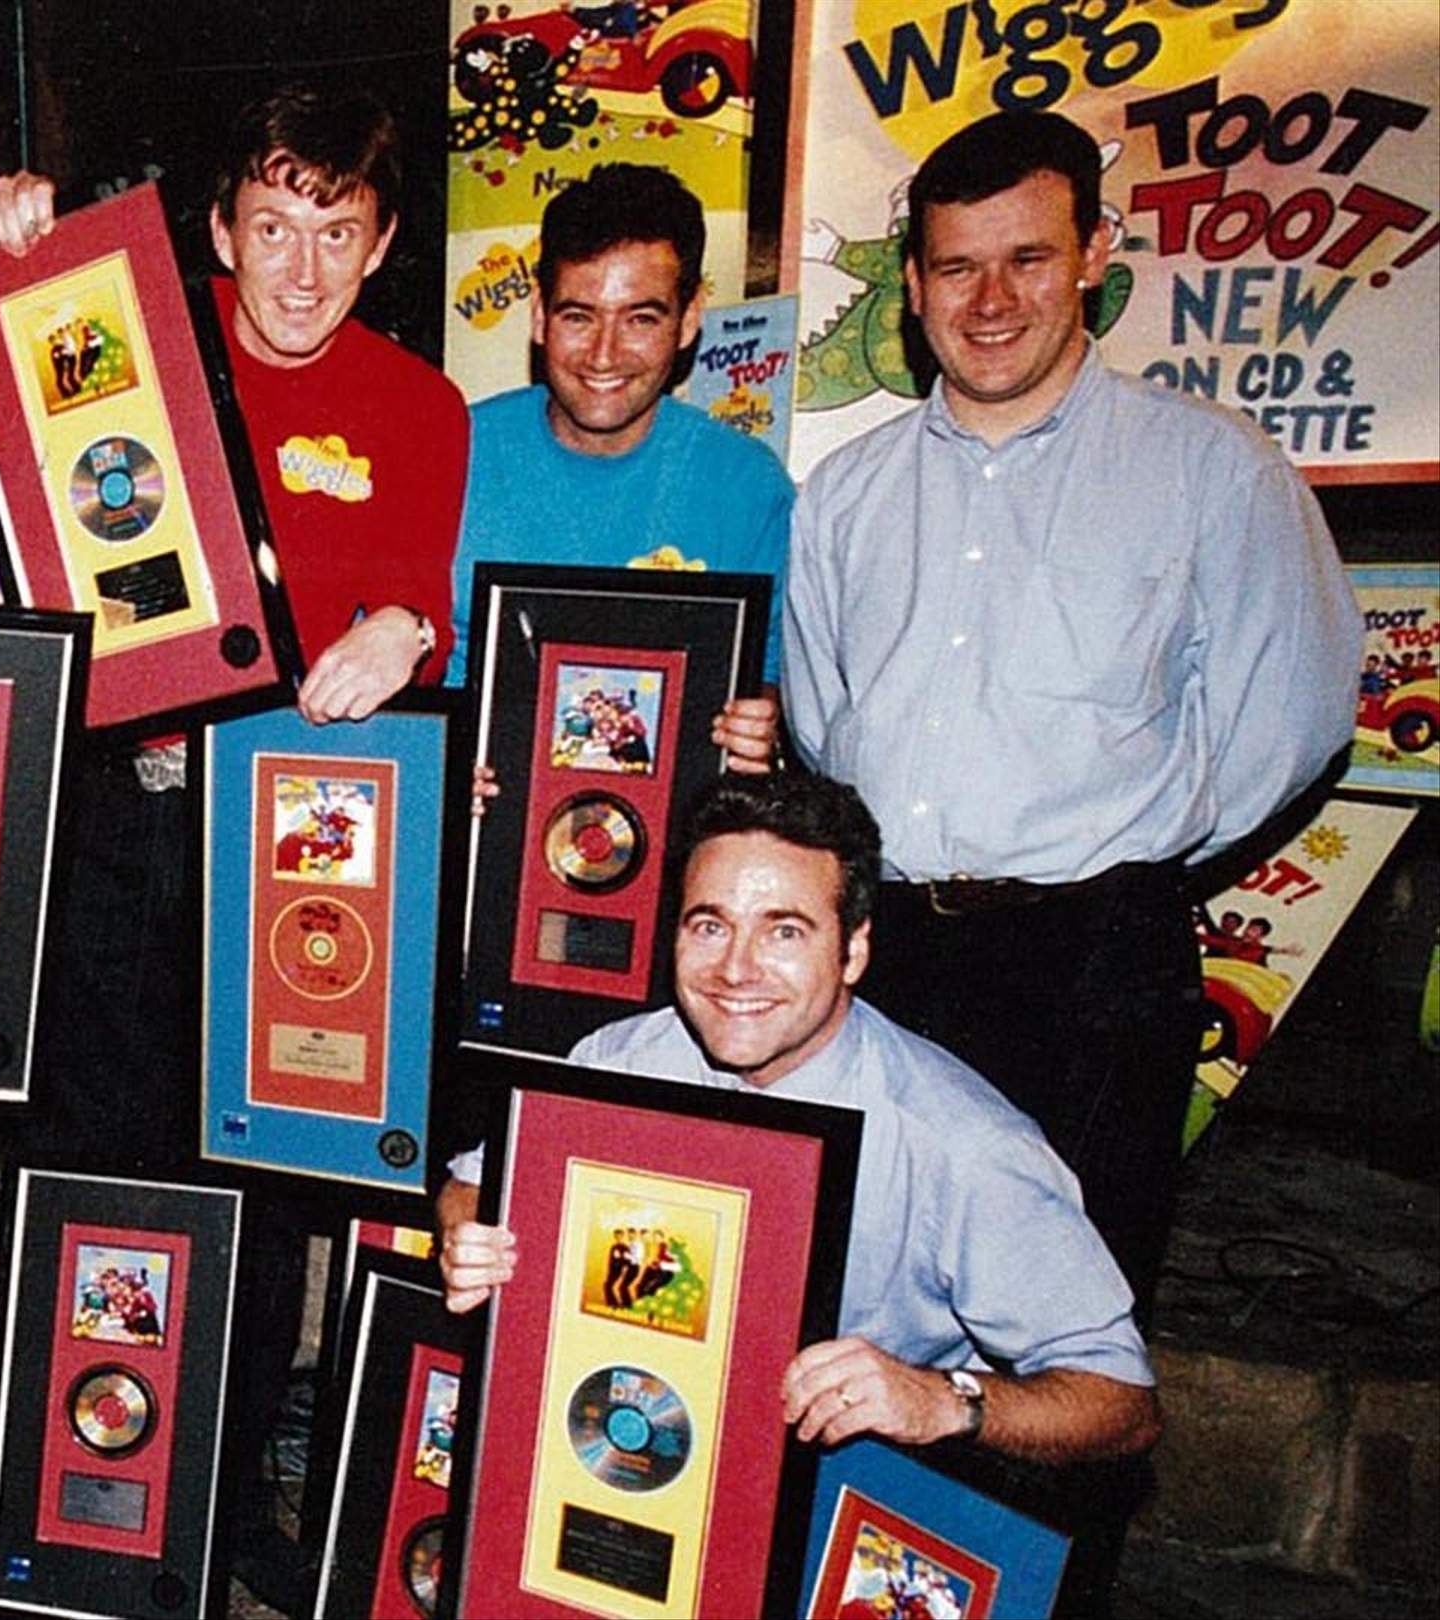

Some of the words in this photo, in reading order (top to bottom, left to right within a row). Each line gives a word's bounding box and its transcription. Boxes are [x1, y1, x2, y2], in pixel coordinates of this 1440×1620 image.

[1125, 75, 1431, 176] TOOT
[1130, 170, 1440, 289] TOOT!
[454, 256, 537, 321] Wiggl
[1171, 266, 1358, 347] NEW
[700, 338, 760, 372] TOOT
[1237, 352, 1303, 401] CD
[1315, 350, 1355, 396] &
[1242, 405, 1376, 452] ETTE
[1363, 608, 1427, 631] TOOT
[1237, 858, 1323, 906] OT!
